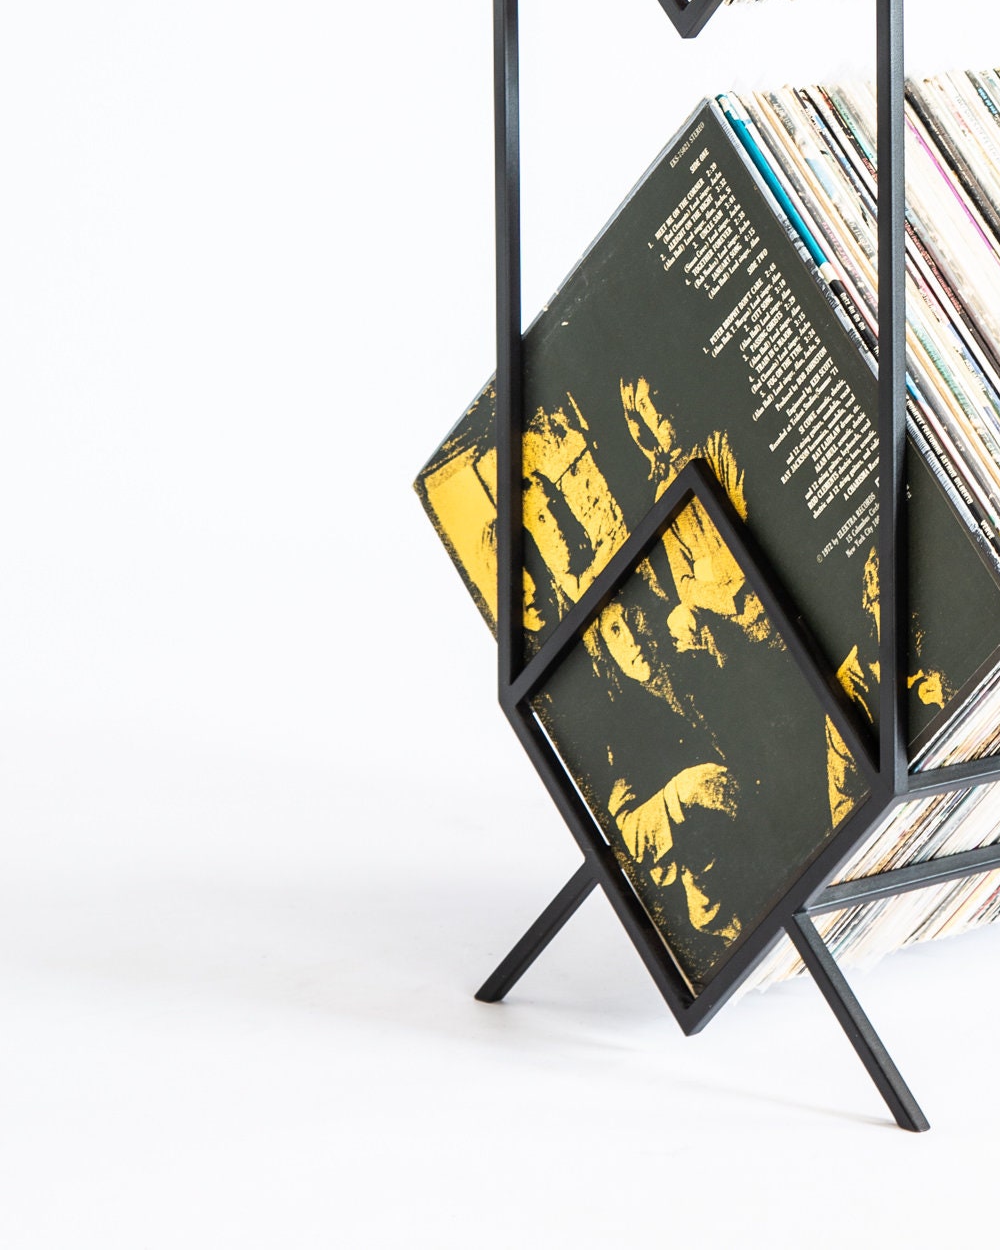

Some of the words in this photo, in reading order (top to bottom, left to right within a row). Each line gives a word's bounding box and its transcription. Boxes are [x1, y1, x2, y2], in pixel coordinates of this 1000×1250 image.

[689, 121, 704, 143] STEREO
[689, 158, 700, 174] SIDE
[699, 147, 709, 161] ONE
[654, 223, 667, 240] MEET
[665, 215, 674, 227] ME
[672, 207, 680, 218] ON
[678, 197, 689, 210] THE
[687, 178, 704, 200] CORNER
[663, 229, 674, 244] (Rod
[672, 209, 690, 232] Clements)
[689, 197, 700, 211] Lead
[699, 186, 712, 200] singer,
[668, 227, 686, 252] ALRIGHT
[684, 219, 693, 230] ON
[691, 209, 701, 222] THE
[699, 193, 713, 212] NIGHT
[715, 178, 727, 193] 3:32
[692, 241, 698, 249] 3.
[699, 220, 714, 239] UNCLE
[712, 209, 723, 224] SAM
[724, 195, 736, 209] 3:01
[691, 249, 714, 276] TOGETHER
[712, 226, 733, 252] FOREVER
[711, 255, 731, 281] JANUARY
[729, 242, 742, 259] SONG
[744, 227, 755, 241] 4:15
[747, 260, 758, 275] SIDE
[756, 248, 768, 263] TWO
[709, 326, 724, 345] PETER
[722, 306, 740, 330] BROPHY
[738, 291, 752, 310] DON'T
[750, 278, 763, 294] CARE
[743, 324, 750, 332] 2.
[751, 307, 762, 322] CITY
[760, 294, 773, 311] SONG
[838, 290, 852, 306] Getz
[851, 311, 862, 323] Go
[749, 329, 768, 352] PASSING
[766, 310, 783, 332] GHOSTS
[755, 354, 770, 373] TRAIN
[768, 348, 775, 358] IN
[773, 344, 779, 352] G
[776, 327, 793, 348] MAJOR
[794, 311, 805, 327] 3:15
[856, 320, 867, 331] Go
[759, 390, 766, 398] 5.
[766, 375, 777, 389] FOG
[775, 367, 783, 378] ON
[781, 356, 792, 370] THE
[789, 343, 803, 360] TYNE
[775, 388, 793, 411] Produced
[791, 383, 798, 392] by
[796, 371, 806, 385] BOB
[805, 346, 827, 375] JOHNSTON
[786, 390, 807, 417] Engineered
[804, 385, 812, 394] by
[810, 373, 820, 387] KEN
[818, 357, 833, 377] SCOTT
[769, 428, 787, 452] Recorded
[786, 424, 792, 432] at
[789, 408, 805, 426] Trident
[830, 366, 838, 375] '71
[786, 452, 794, 465] and
[792, 446, 800, 456] 12
[799, 435, 811, 449] string
[809, 421, 824, 438] guitars,
[840, 384, 850, 399] vocal
[798, 425, 805, 434] SI
[803, 410, 817, 428] COWE
[816, 396, 832, 414] acoustic,
[780, 469, 791, 484] RAY
[790, 448, 810, 473] JACKSON
[845, 393, 855, 408] vocal
[805, 487, 813, 500] and
[811, 481, 819, 491] 12
[818, 470, 829, 485] string
[828, 456, 842, 473] guitars,
[860, 418, 871, 433] vocal
[811, 447, 822, 462] RAY
[820, 424, 840, 451] LAIDLAW
[840, 413, 854, 428] drums,
[814, 456, 827, 473] ALAN
[825, 444, 838, 460] HULL
[837, 428, 853, 447] acoustic,
[918, 423, 944, 456] FEATURING
[937, 453, 958, 479] ASTRUD
[951, 475, 975, 505] GILBERTO
[807, 495, 818, 510] ROD
[817, 471, 839, 498] CLEMENTS
[838, 458, 852, 475] electric
[813, 502, 827, 519] electric
[826, 491, 834, 504] and
[832, 485, 840, 495] 12
[839, 474, 851, 488] string
[849, 460, 864, 477] guitars,
[862, 448, 871, 460] and
[843, 493, 849, 501] A
[847, 468, 870, 495] CHARISMA
[821, 542, 833, 557] 1972
[836, 515, 857, 539] ELEKTRA
[855, 492, 875, 517] RECORDS
[845, 534, 853, 543] 15
[851, 516, 870, 536] Columbus
[845, 546, 855, 558] New
[854, 534, 866, 546] York
[864, 526, 873, 536] City
[979, 517, 997, 540] VERVE
